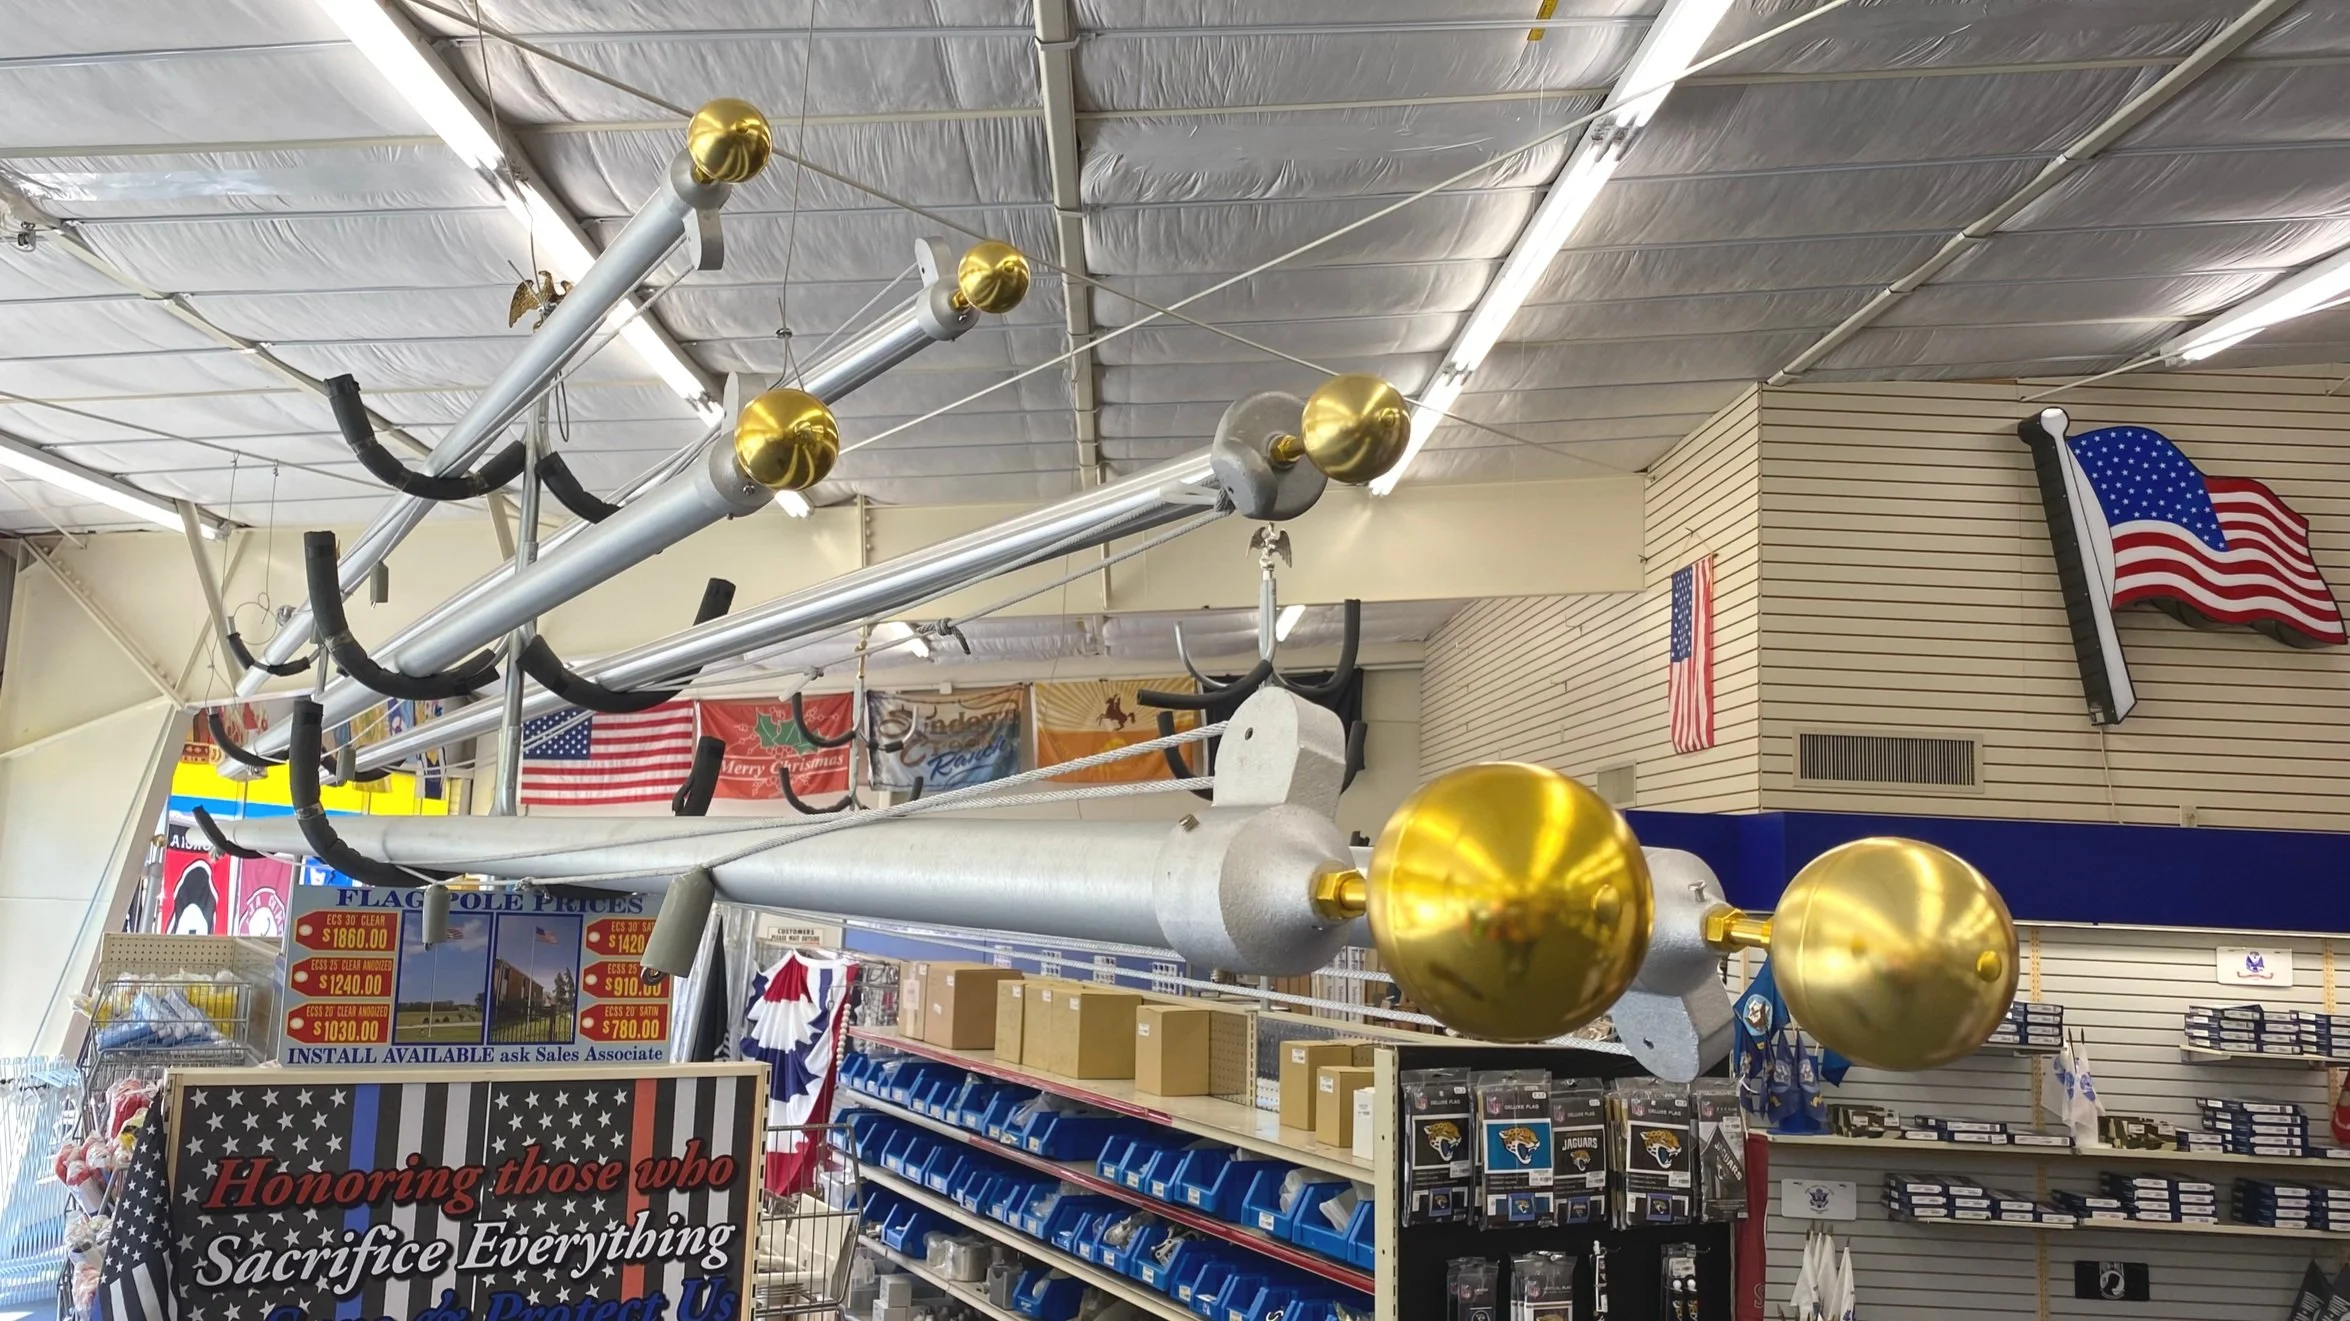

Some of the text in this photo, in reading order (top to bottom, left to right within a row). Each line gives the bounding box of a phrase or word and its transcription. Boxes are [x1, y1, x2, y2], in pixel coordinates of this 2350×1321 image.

[719, 759, 765, 777] Merry
[335, 889, 424, 909] FLAG
[532, 894, 643, 914] PRICES
[326, 914, 342, 926] ECS
[361, 914, 385, 926] CLEAR
[611, 921, 625, 932] ECS
[322, 928, 387, 949] $1860.00
[609, 934, 646, 953] $1420
[311, 959, 328, 971] ECSS
[342, 960, 361, 971] CLEAR
[363, 960, 392, 971] ANODIZED
[608, 963, 626, 975] ECSS
[319, 974, 382, 995] $1240.00
[306, 1006, 324, 1017] ECSS
[337, 1006, 356, 1017] CLEAR
[359, 1006, 388, 1018] ANODIZED
[605, 1006, 623, 1017] ECSS
[639, 1006, 659, 1017] SATIN
[313, 1021, 379, 1041] $1030.00
[602, 1019, 660, 1039] $780.00
[287, 1046, 663, 1065] INSTALL AVAILABLE ask Sales Associate
[1562, 1137, 1598, 1151] JAGUARS
[201, 1139, 736, 1216] Honoring those who
[196, 1210, 736, 1294] Sacrifice Everything
[677, 1276, 738, 1321] Us
